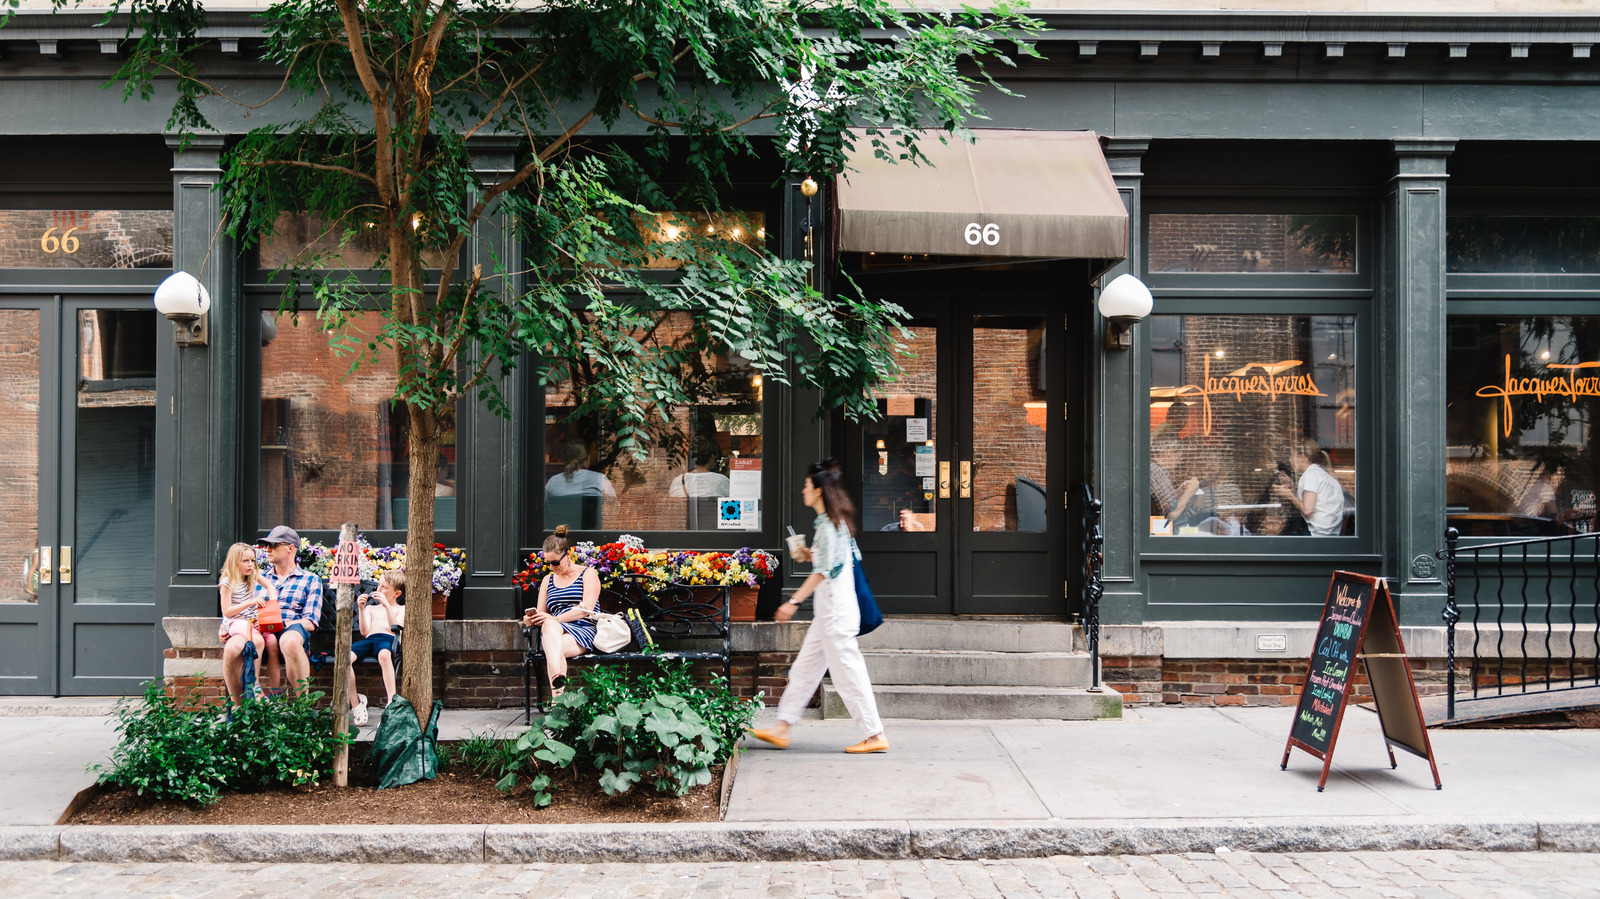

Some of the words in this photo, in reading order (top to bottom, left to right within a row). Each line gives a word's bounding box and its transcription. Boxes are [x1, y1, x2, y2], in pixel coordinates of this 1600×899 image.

[964, 222, 1000, 246] 66
[41, 226, 80, 254] 66
[340, 542, 354, 553] NO
[335, 554, 359, 565] RKIN
[333, 566, 359, 577] ONDA
